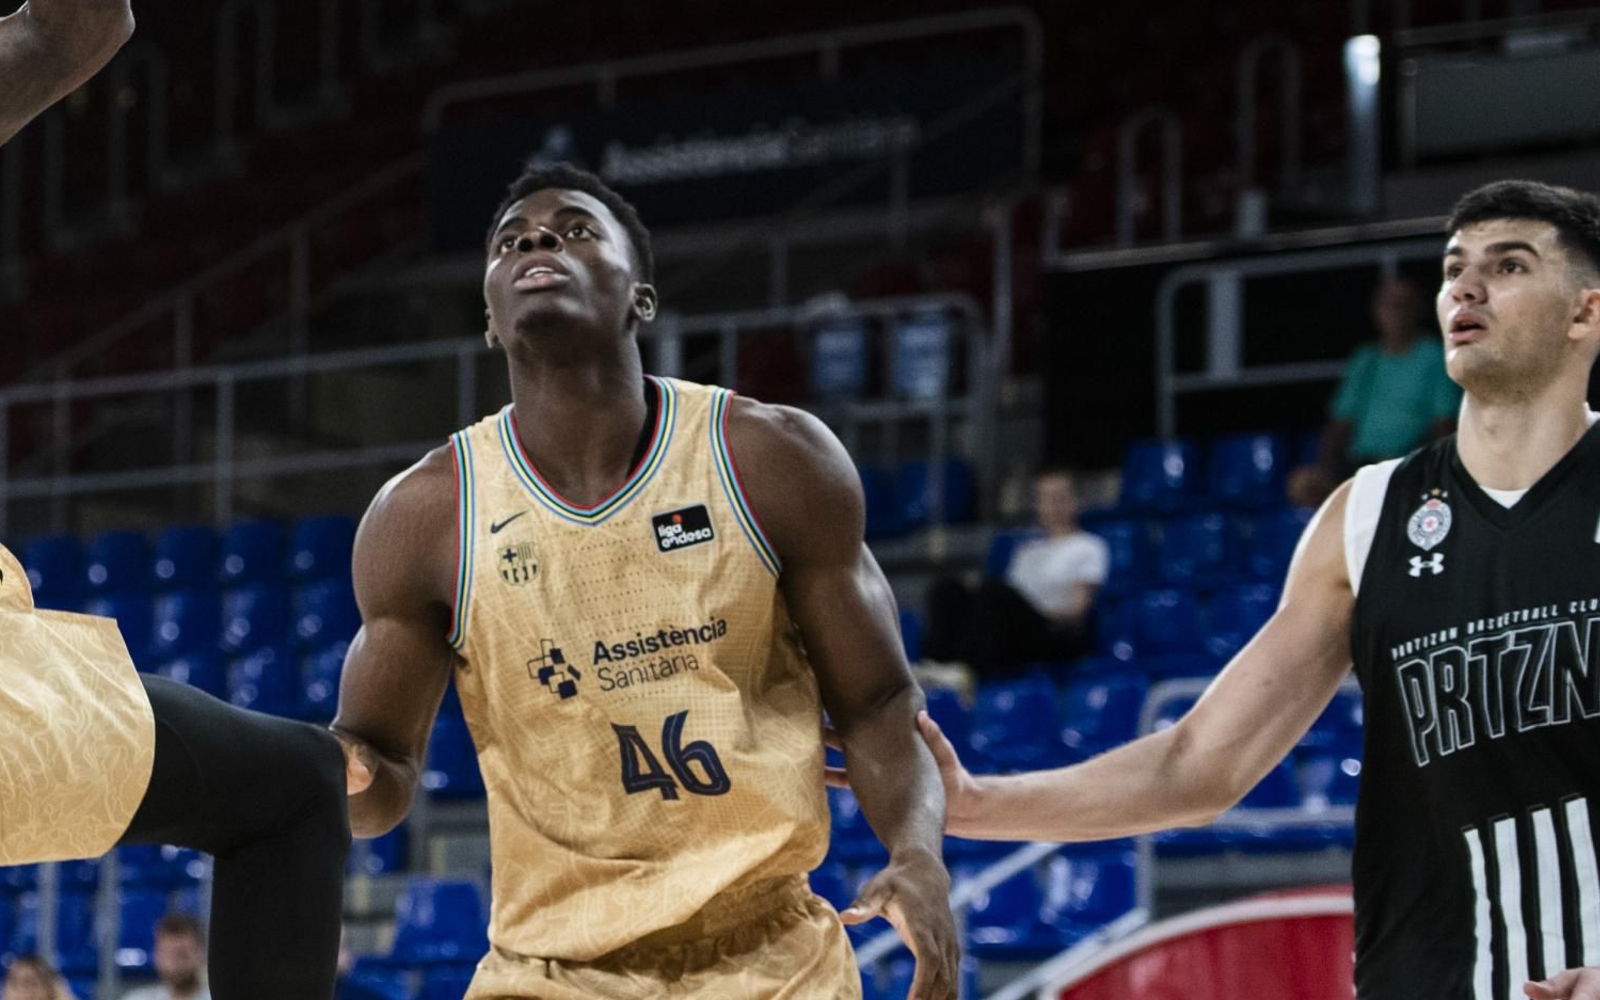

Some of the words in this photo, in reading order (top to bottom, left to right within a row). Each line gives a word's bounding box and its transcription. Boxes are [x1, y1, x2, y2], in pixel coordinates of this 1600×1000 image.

[593, 615, 728, 666] Assistència
[1467, 604, 1559, 635] BASKETBALL
[1569, 598, 1600, 614] CLU
[597, 653, 699, 692] Sanitària
[1397, 617, 1600, 768] PRTZN
[610, 709, 732, 801] 46
